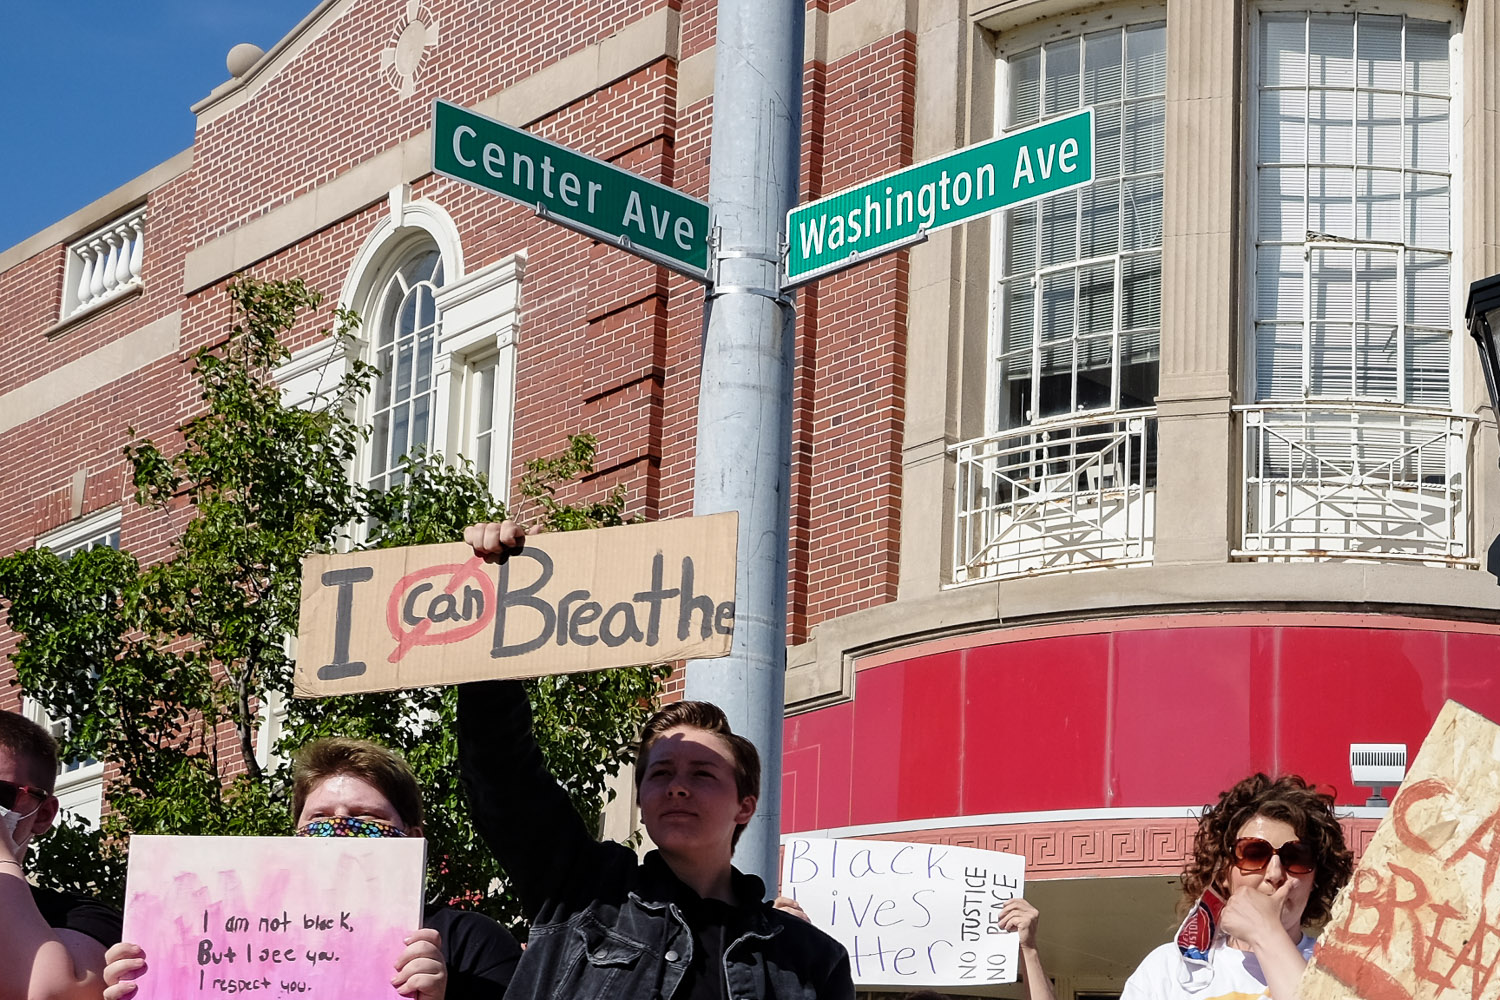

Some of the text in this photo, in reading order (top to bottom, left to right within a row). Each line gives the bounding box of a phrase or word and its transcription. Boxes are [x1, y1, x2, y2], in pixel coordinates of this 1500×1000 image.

[451, 125, 696, 252] Center Ave
[799, 133, 1080, 260] Washington Ave
[317, 547, 735, 681] I can Breathe
[790, 840, 955, 884] Black
[203, 909, 208, 934] I
[225, 915, 250, 933] am
[259, 911, 292, 933] not
[958, 866, 988, 980] NO JUSTICE
[1188, 912, 1198, 945] ISTONS
[197, 939, 236, 966] But
[247, 943, 252, 963] I
[258, 948, 297, 963] see
[850, 935, 954, 977] tter
[986, 953, 1007, 981] NO
[199, 969, 312, 994] I respect you.
